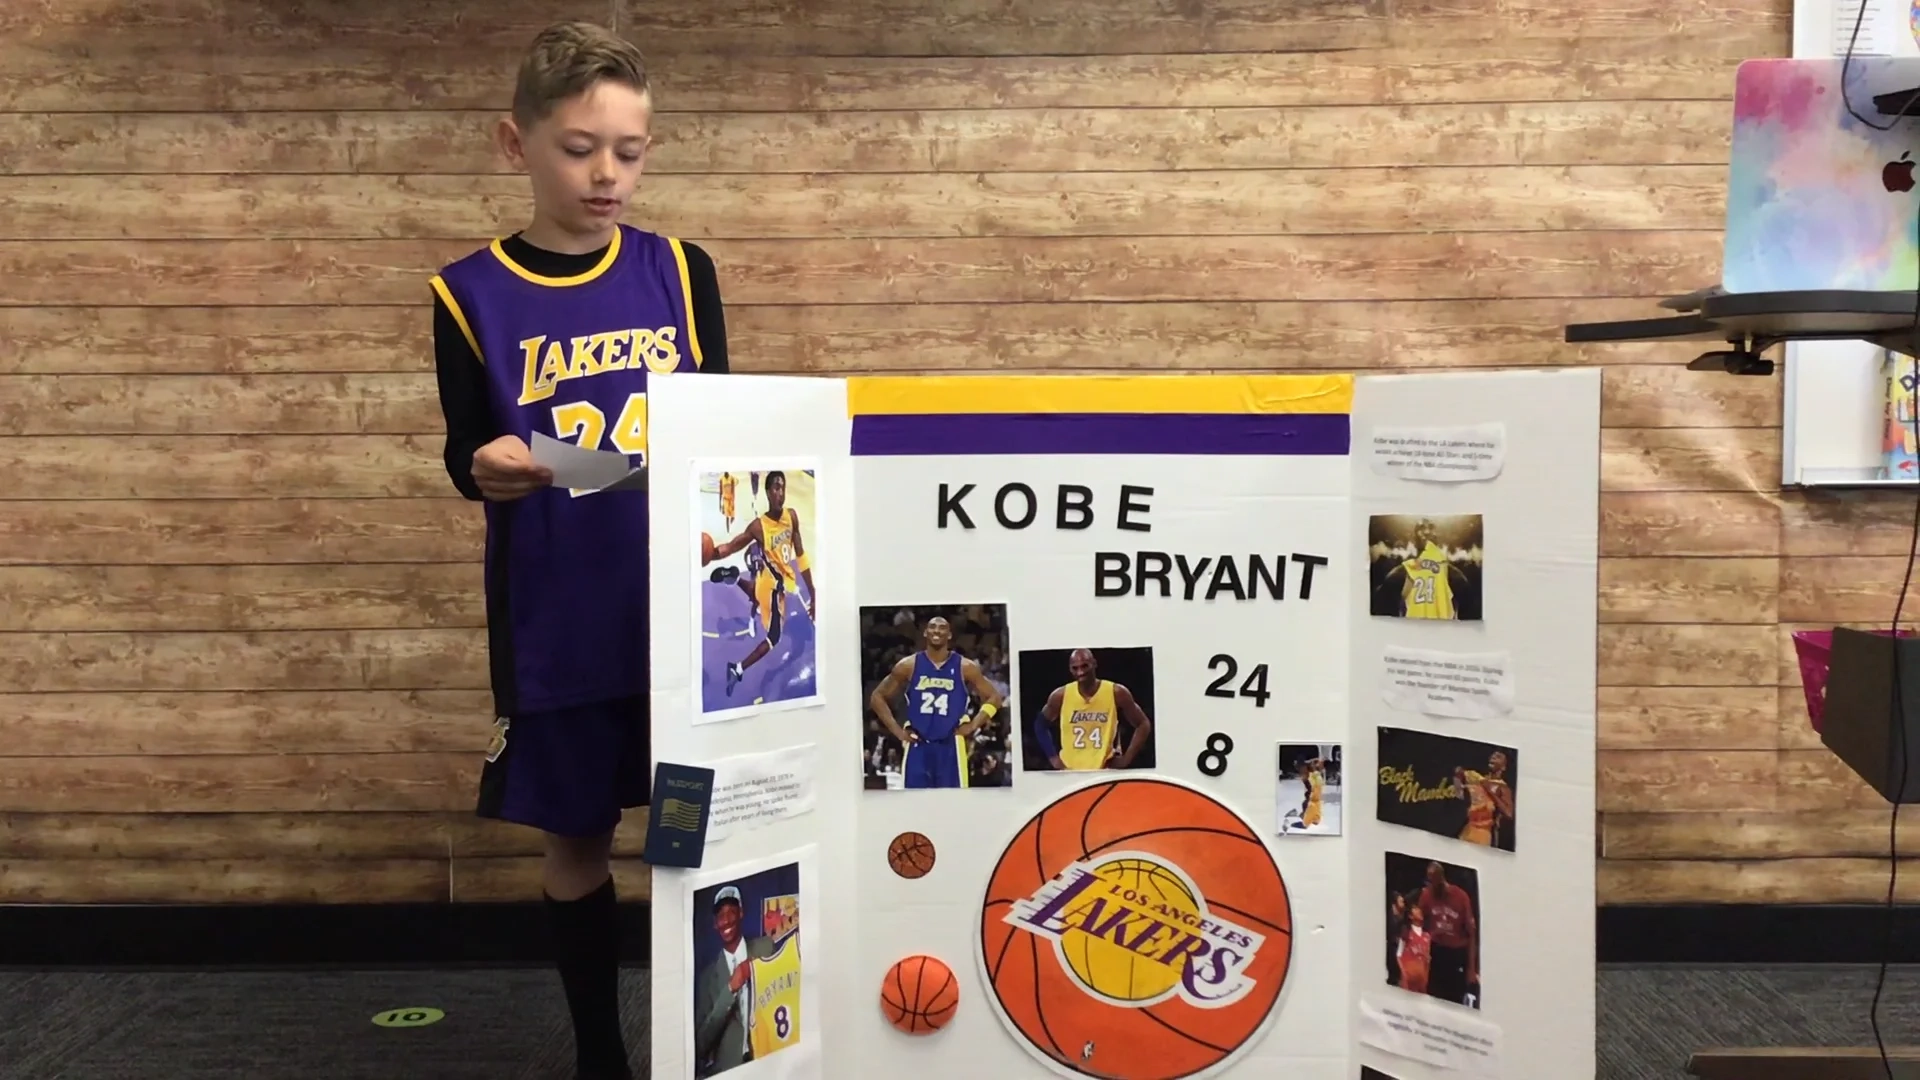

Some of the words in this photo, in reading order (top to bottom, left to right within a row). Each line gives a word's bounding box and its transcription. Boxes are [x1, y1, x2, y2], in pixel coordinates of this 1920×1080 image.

[517, 326, 681, 406] LAKERS
[551, 392, 648, 498] 24
[937, 482, 1154, 532] KOBE
[781, 543, 791, 564] 8
[1095, 551, 1328, 600] BRYANT
[1413, 576, 1434, 605] 24
[1205, 653, 1271, 708] 24
[920, 692, 949, 716] 24
[1069, 710, 1109, 724] LAKERS
[1073, 726, 1103, 749] 24
[1197, 732, 1234, 776] 8
[1395, 777, 1458, 803] Mamba
[1017, 868, 1244, 1000] LAKERS
[1108, 884, 1149, 907] LOS
[1152, 903, 1253, 949] ANGELES
[774, 1005, 790, 1039] 8
